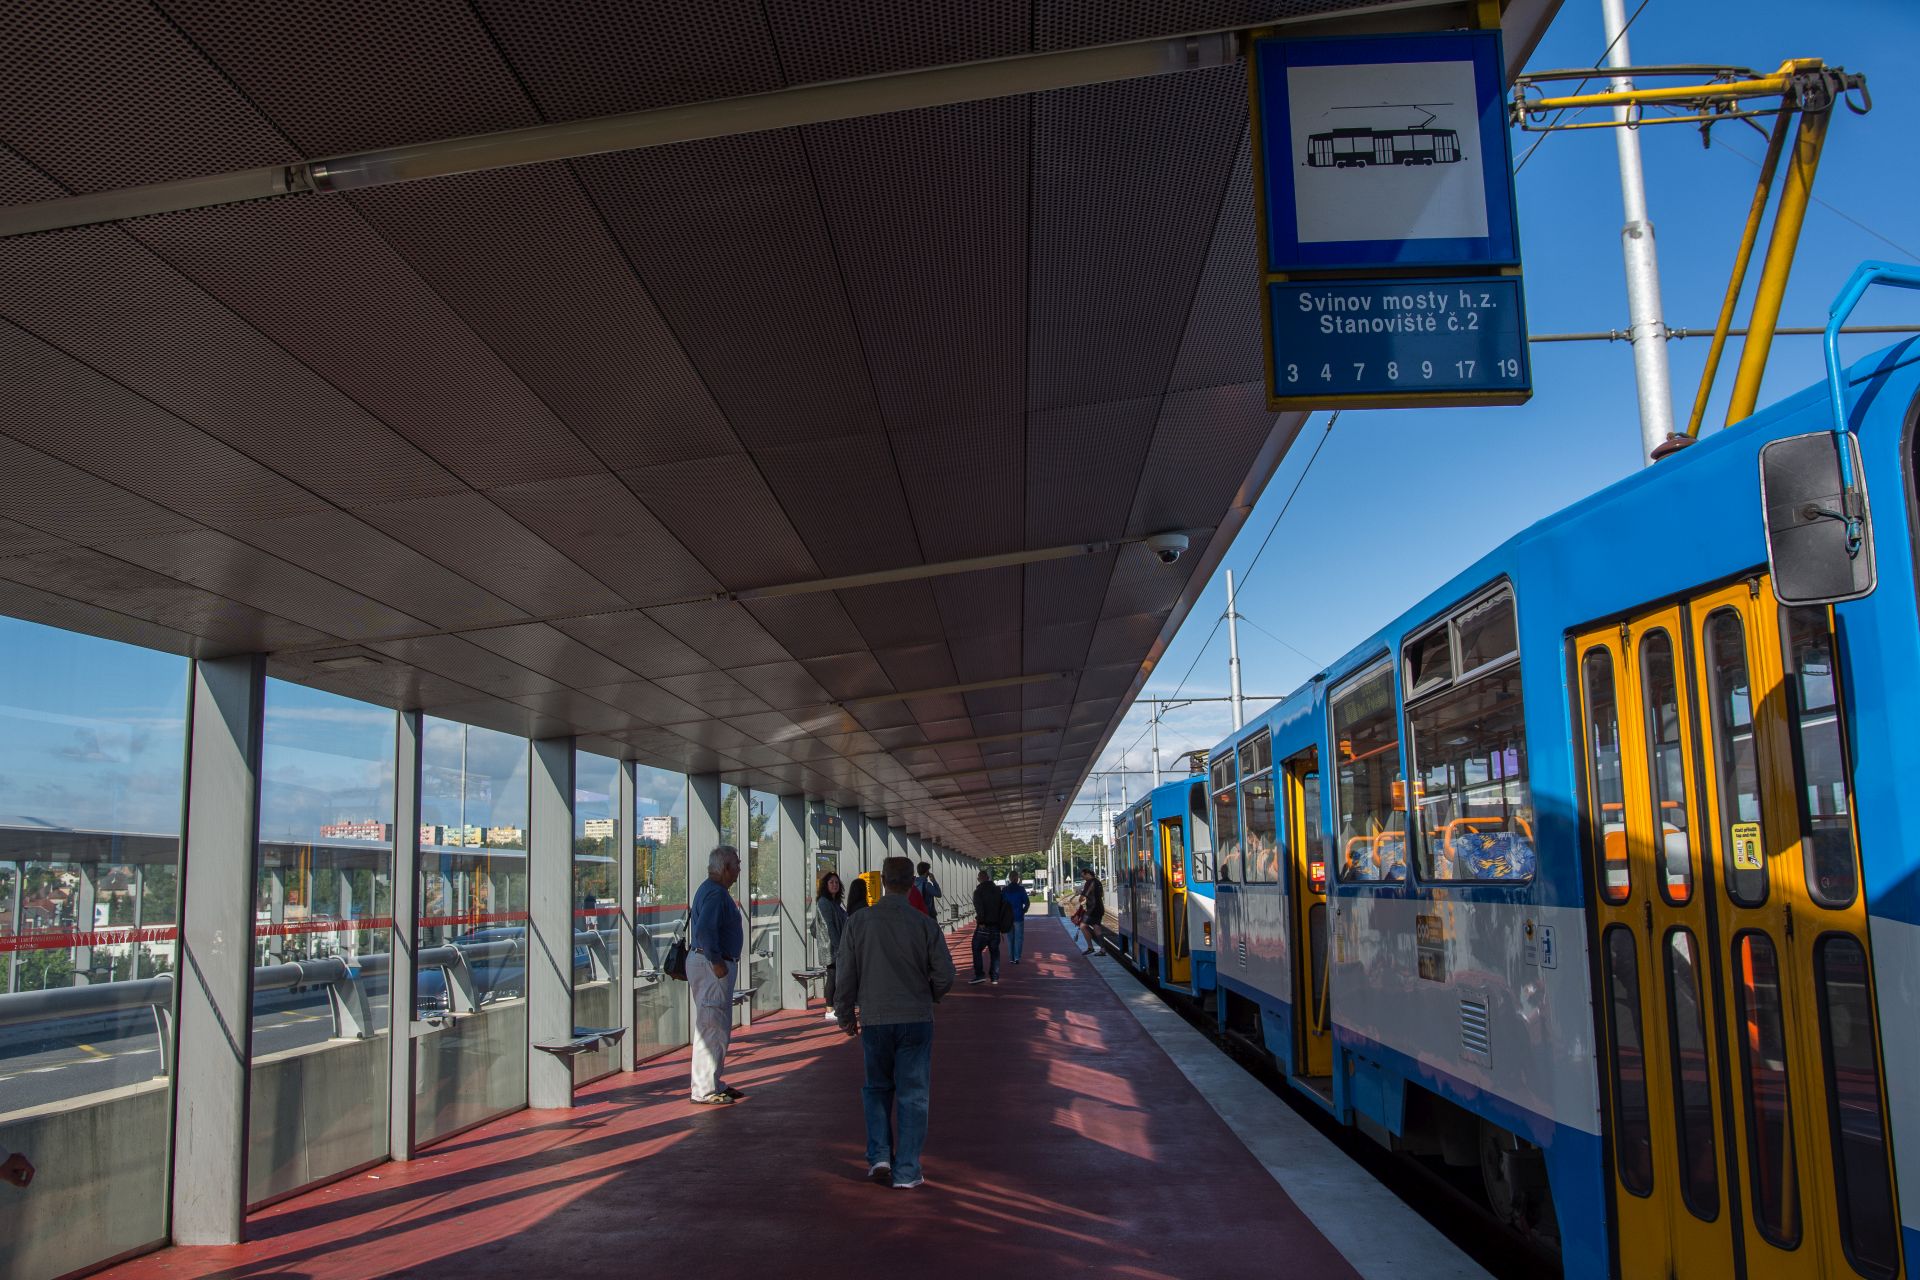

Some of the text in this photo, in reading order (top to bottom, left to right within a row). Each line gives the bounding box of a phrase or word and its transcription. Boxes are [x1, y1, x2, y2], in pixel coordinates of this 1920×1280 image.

[1299, 289, 1497, 314] Svinov mosty h.z.
[1320, 311, 1479, 334] Stanoviště č.2
[1287, 358, 1519, 383] 3 4 7 8 9 17 19
